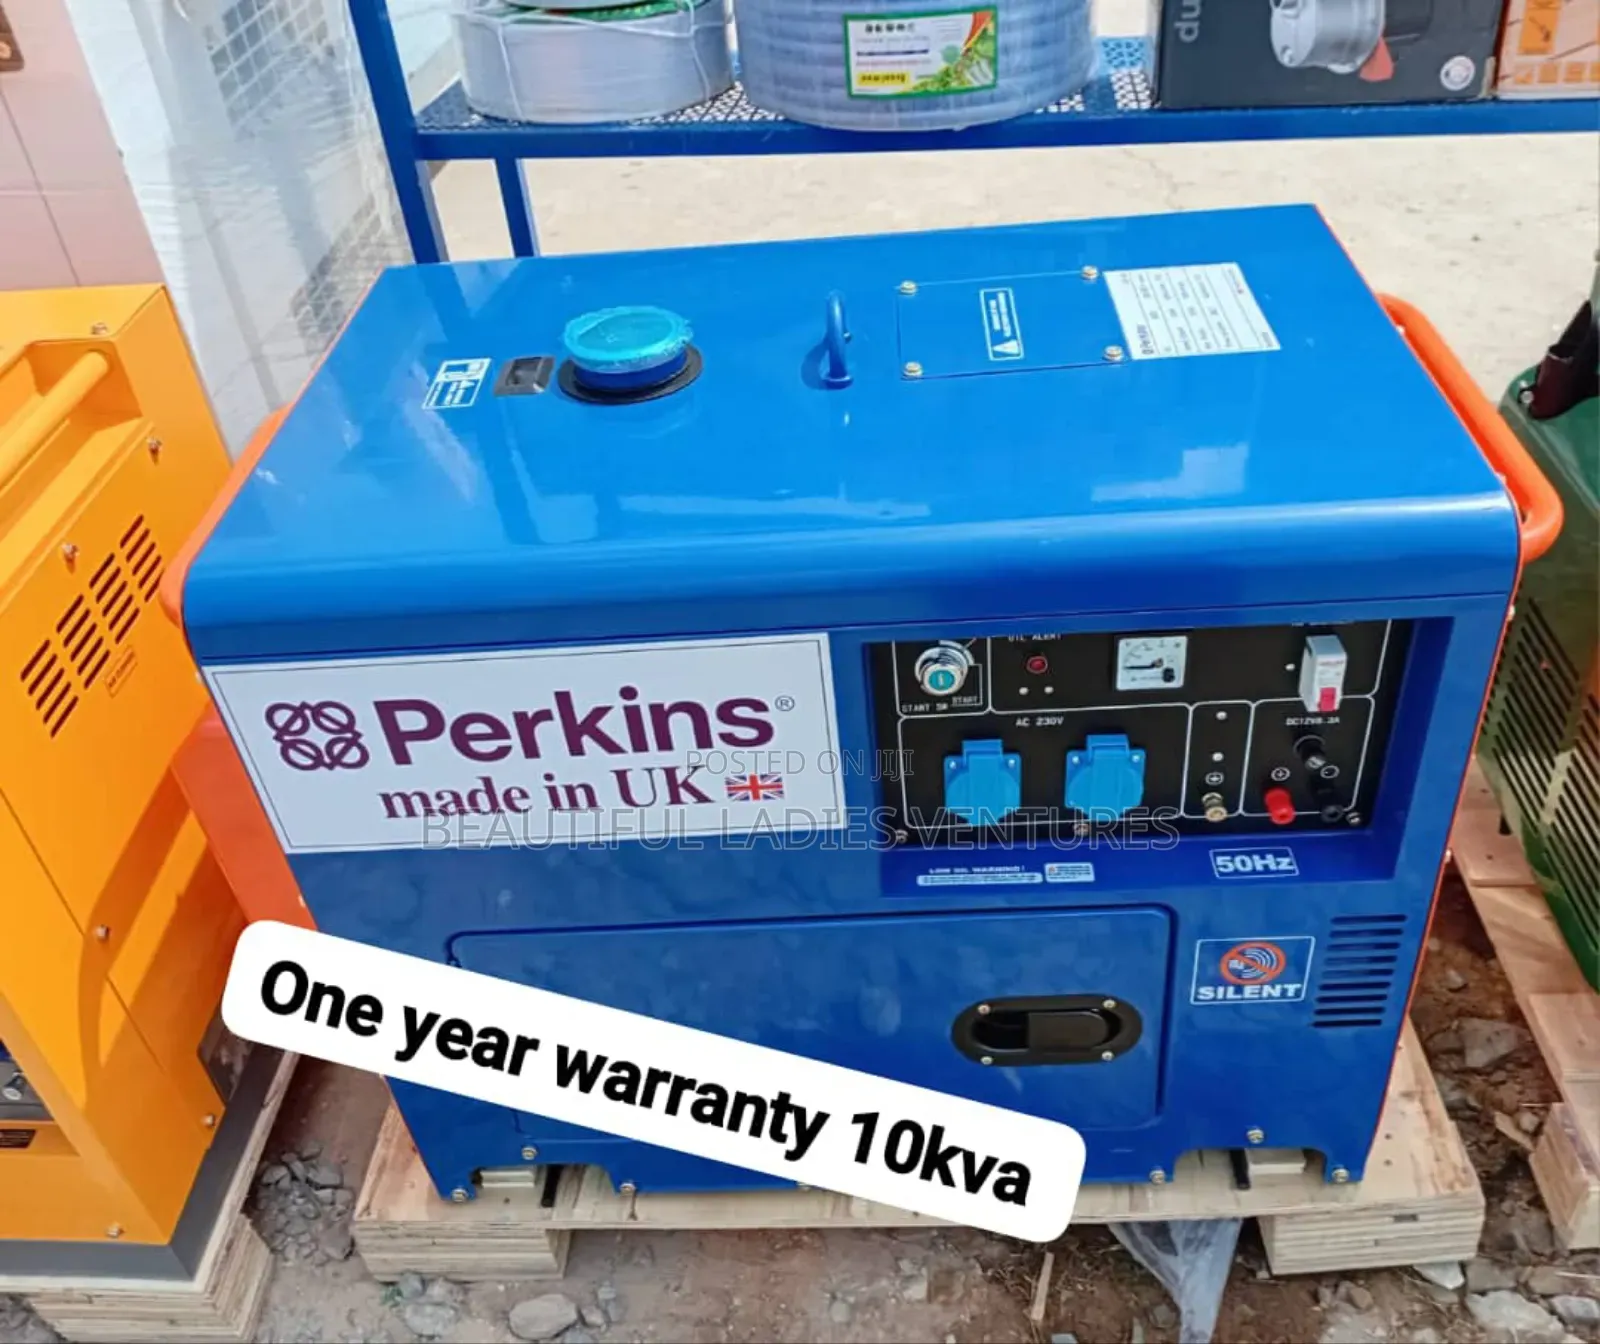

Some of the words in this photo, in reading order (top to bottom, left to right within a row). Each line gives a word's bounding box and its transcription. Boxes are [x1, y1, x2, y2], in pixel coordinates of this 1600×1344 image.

[374, 686, 774, 765] Perkins
[1015, 717, 1030, 728] AC
[1035, 715, 1065, 727] 230V
[378, 775, 533, 819] made
[543, 773, 602, 812] in
[611, 764, 716, 808] UK
[1216, 853, 1295, 873] 50Hz
[1197, 983, 1303, 1001] SILENT
